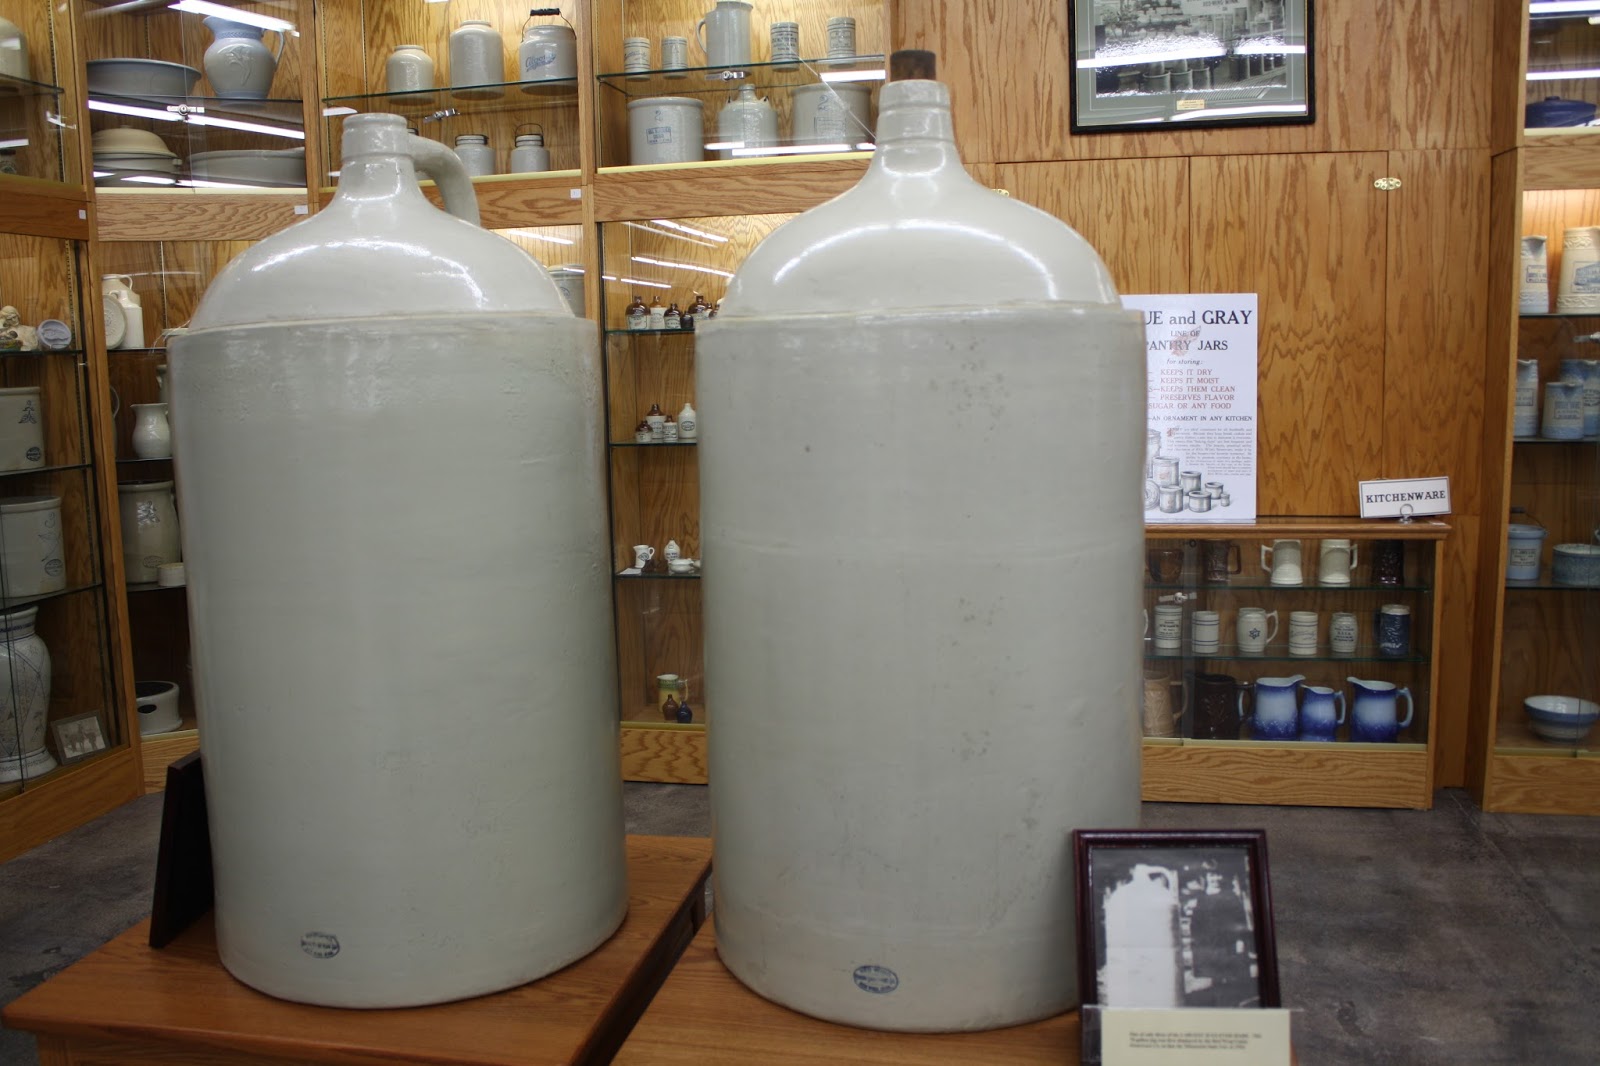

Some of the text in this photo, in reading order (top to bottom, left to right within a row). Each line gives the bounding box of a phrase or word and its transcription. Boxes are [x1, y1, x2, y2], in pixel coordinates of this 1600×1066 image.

[1146, 310, 1252, 325] UE and GRAY
[1147, 340, 1229, 351] ANTRY JARS
[1366, 490, 1446, 504] KITCHENWARE
